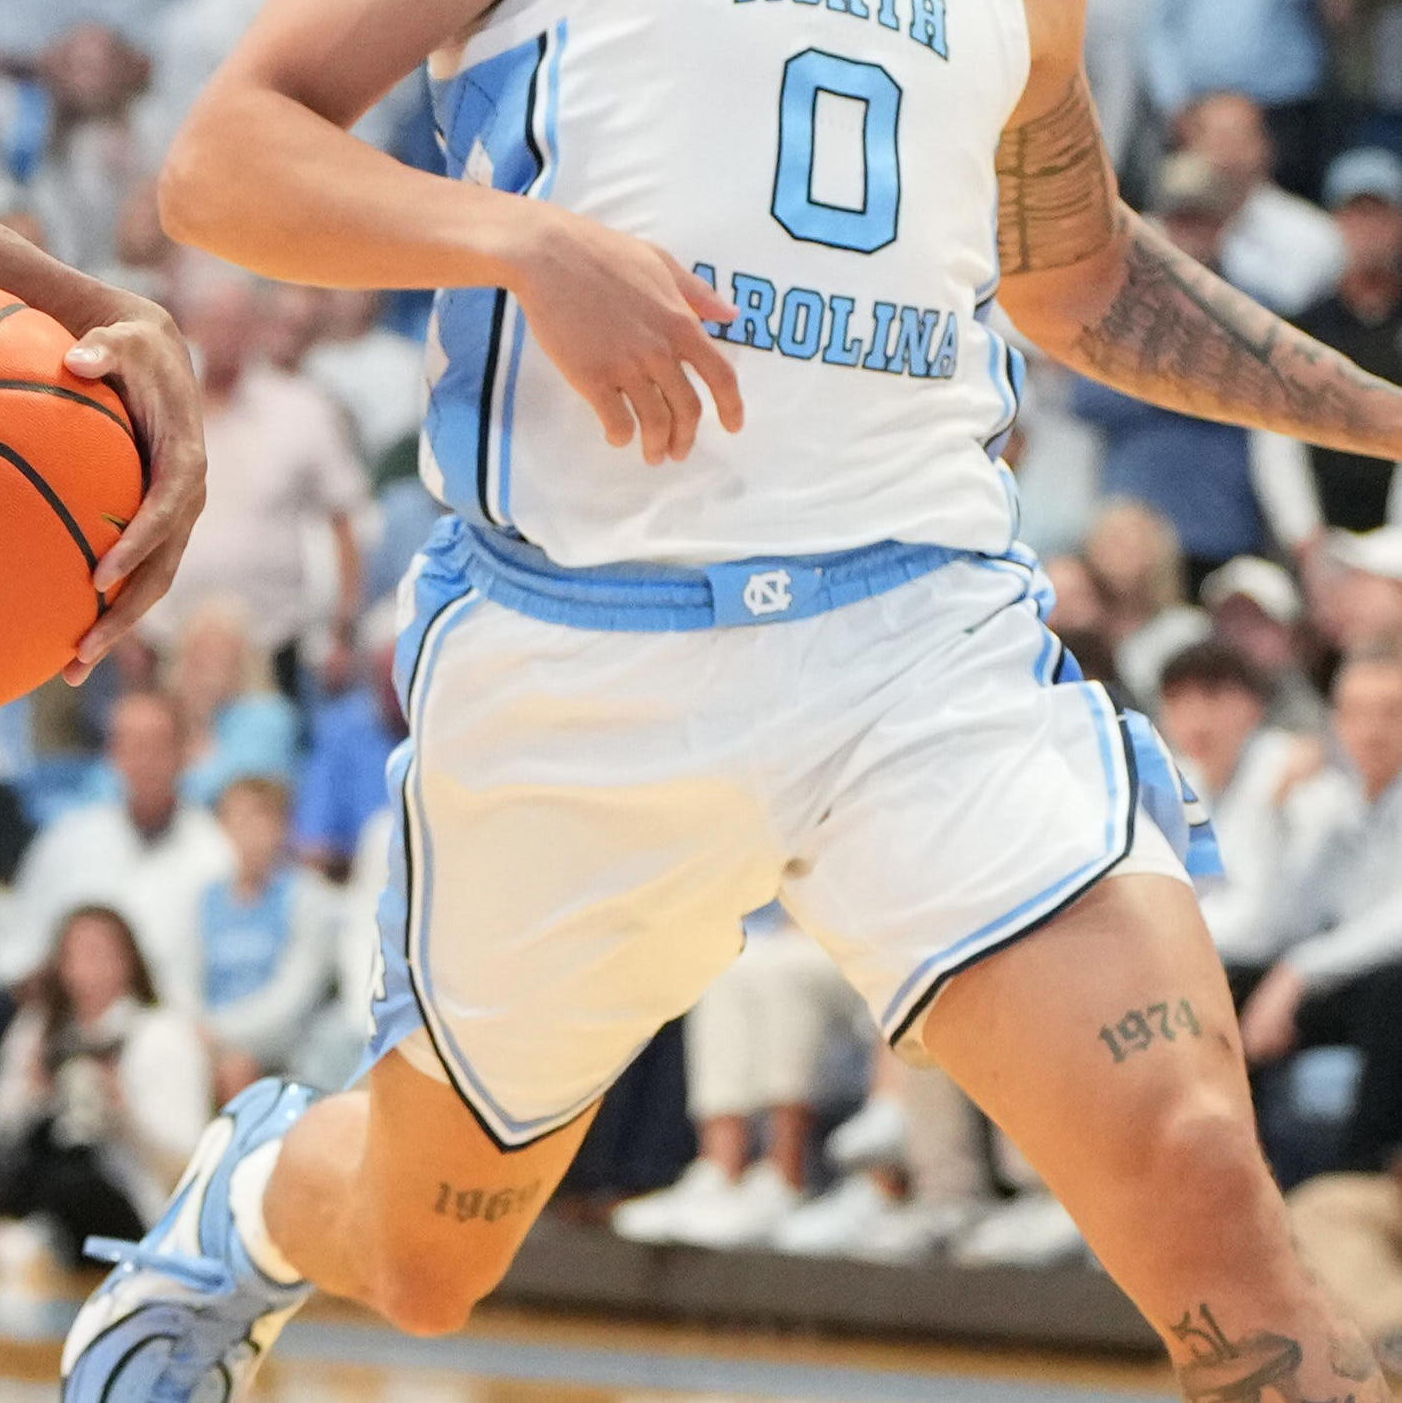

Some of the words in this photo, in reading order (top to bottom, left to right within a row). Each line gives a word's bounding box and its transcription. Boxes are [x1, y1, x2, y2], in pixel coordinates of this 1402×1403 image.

[771, 47, 902, 254] 0
[1098, 997, 1201, 1063] 1974
[435, 1180, 541, 1223] 196
